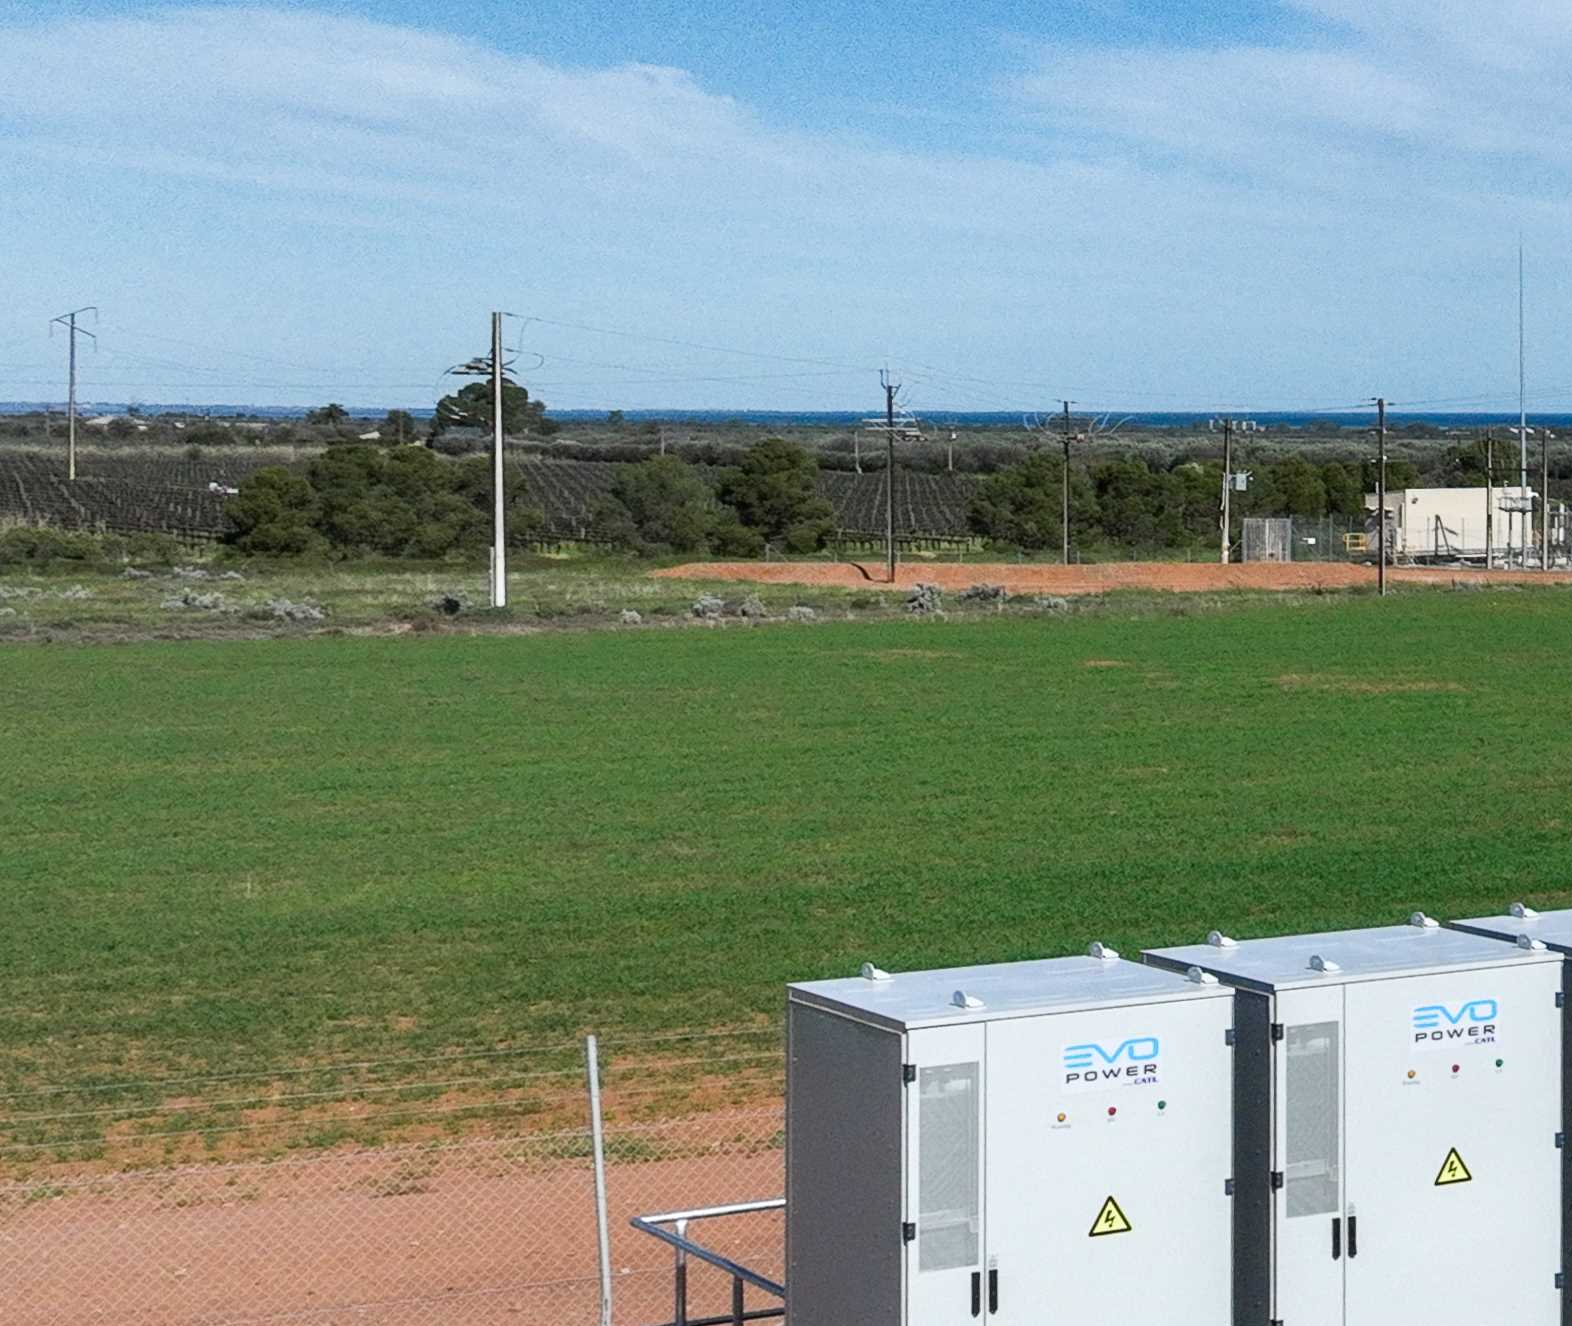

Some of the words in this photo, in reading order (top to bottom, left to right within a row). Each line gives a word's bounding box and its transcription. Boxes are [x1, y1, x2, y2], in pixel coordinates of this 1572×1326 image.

[1413, 999, 1497, 1028] EVO
[1415, 1024, 1495, 1042] POWER
[1064, 1037, 1158, 1068] EVO
[1066, 1064, 1157, 1084] POWER
